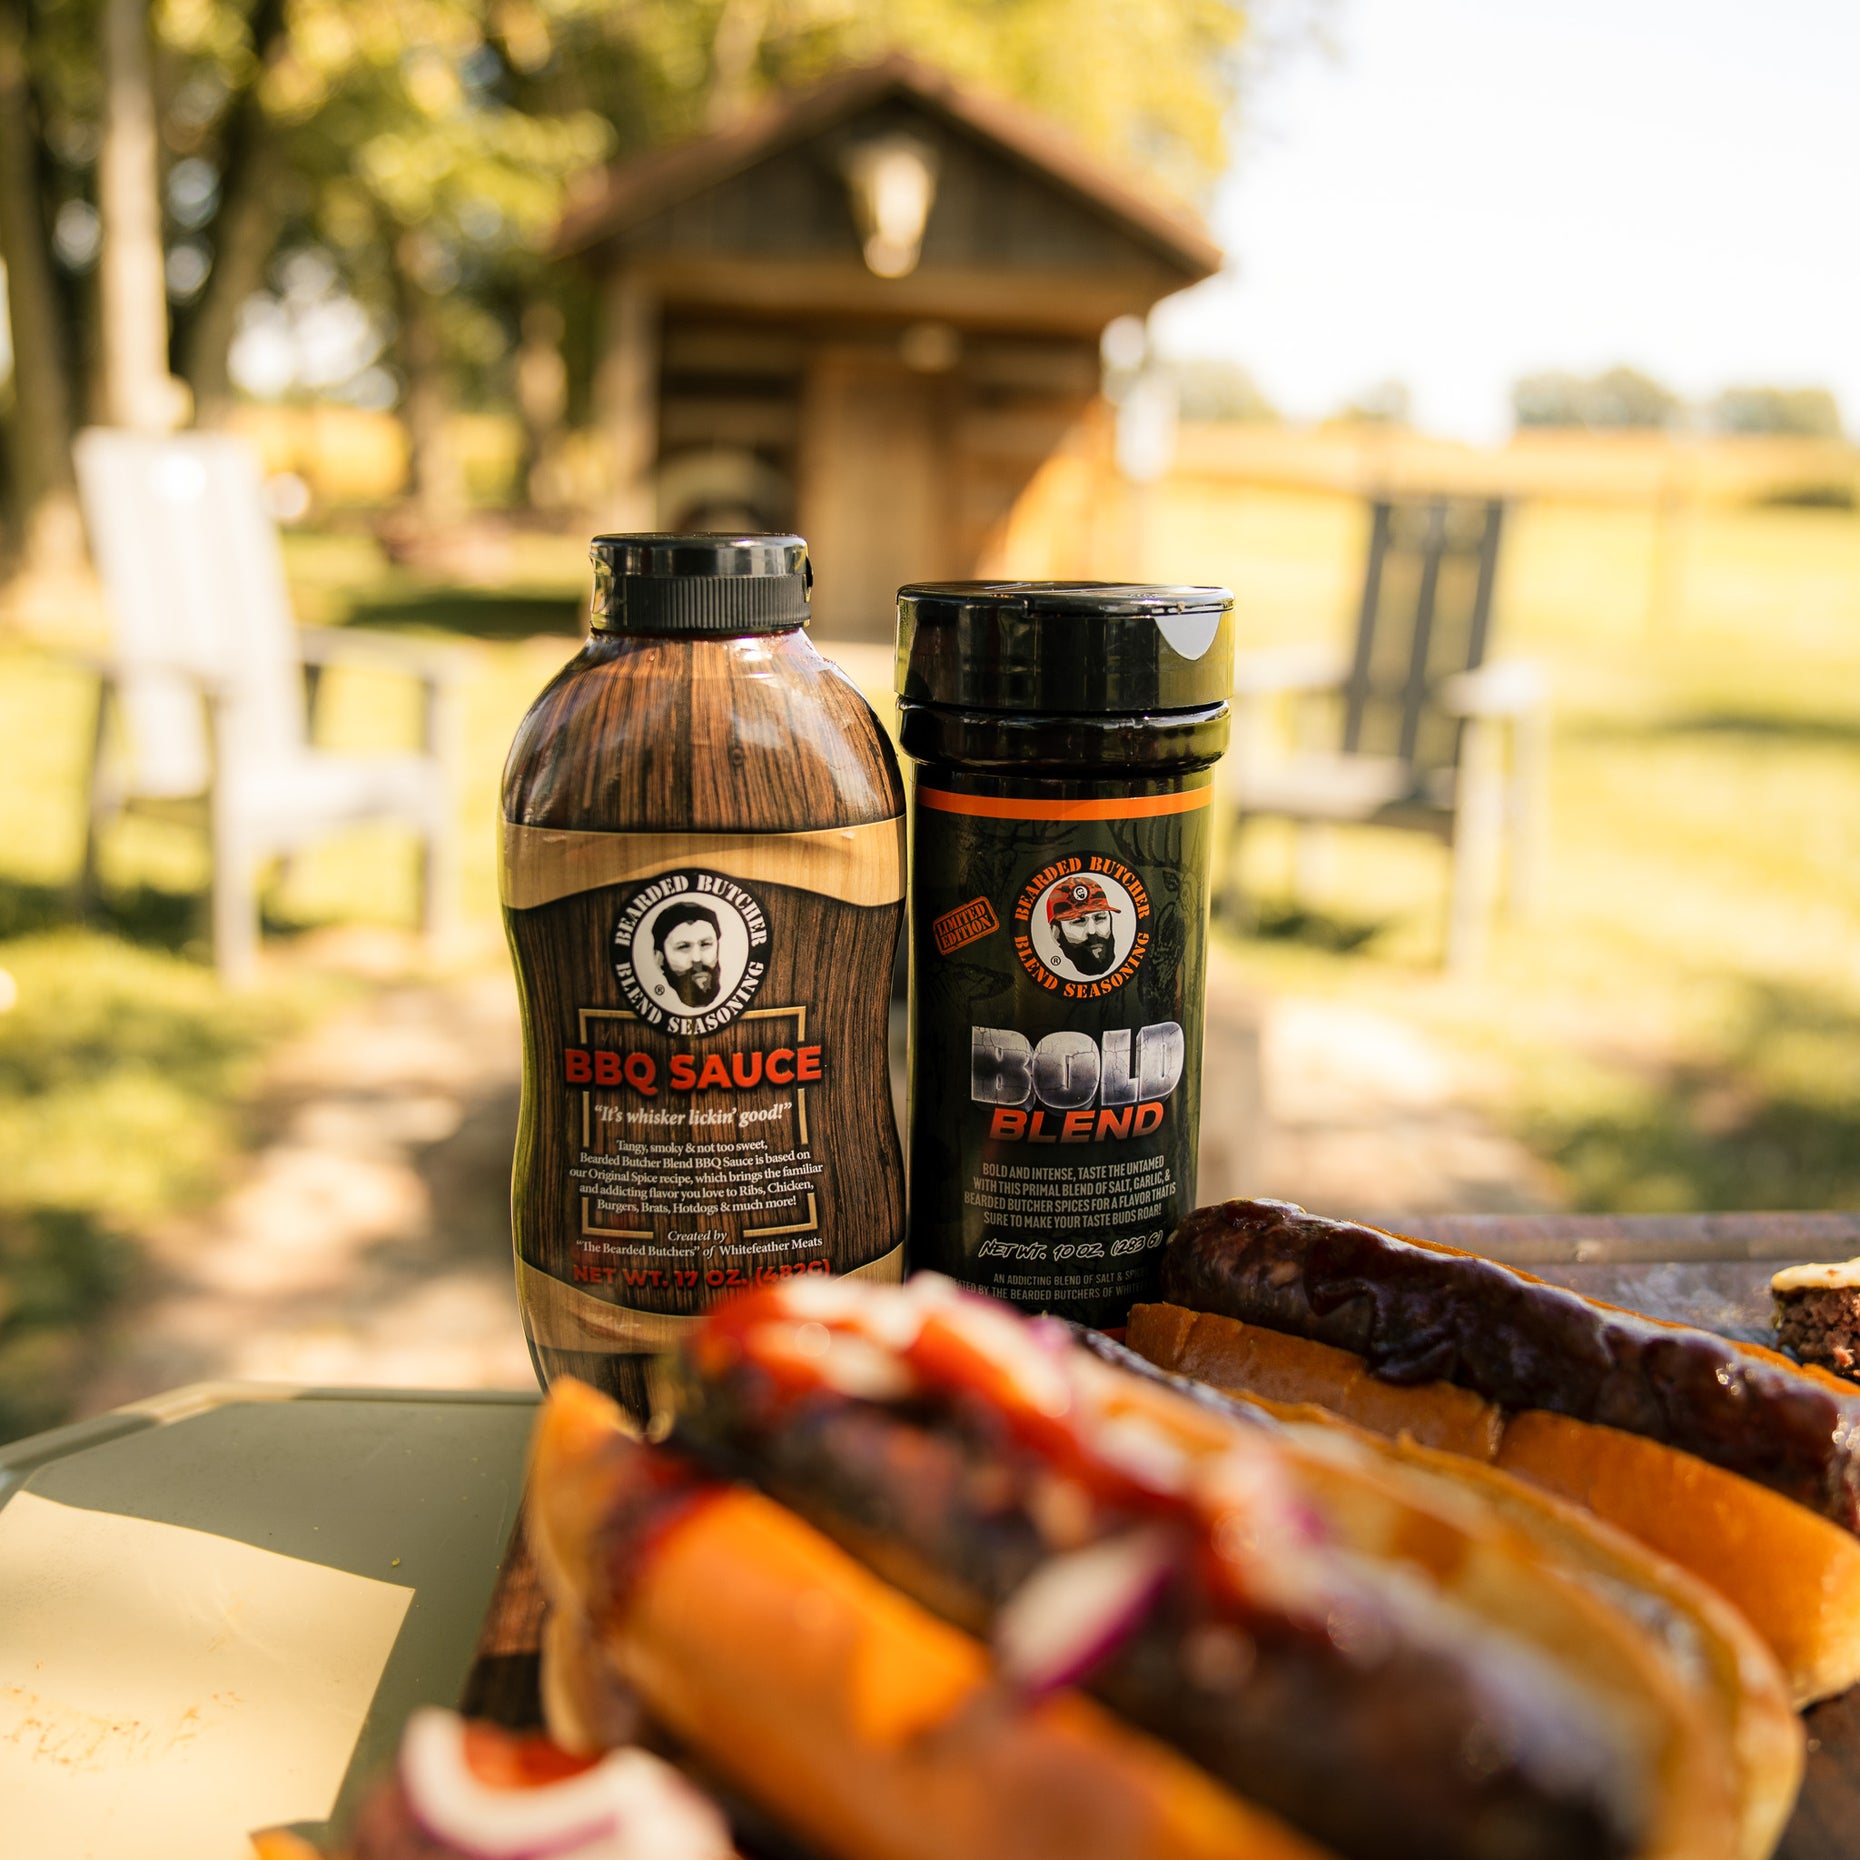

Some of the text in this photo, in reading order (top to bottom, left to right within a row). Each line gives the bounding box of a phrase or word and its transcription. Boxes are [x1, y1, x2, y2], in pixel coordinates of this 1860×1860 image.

[1014, 856, 1150, 922] BEARDED BUTCHER
[614, 874, 769, 947] BEARDED BUTCHER
[937, 903, 985, 936] LIMITED
[941, 914, 991, 949] EDITION
[1014, 932, 1150, 999] BLEND SEASONING
[616, 961, 764, 1036] BLEND SEASONING
[565, 1045, 822, 1096] BBQ SAUCE
[970, 1021, 1185, 1110] BOLD
[626, 1107, 686, 1125] whisker
[989, 1101, 1165, 1144] BLEND
[580, 1150, 811, 1170] Bearded Butcher Blend BBQ Sauce is based on
[616, 1140, 768, 1156] Tangy, smoky & not too sweet,
[569, 1163, 824, 1187] our Original Spice recipe, which brings the familiar
[982, 1154, 1164, 1182] BOLD AND INTENSE, TASTE THE UNTAMED
[579, 1180, 815, 1201] and addicting flavor you love to Ribs, Chicken,
[973, 1168, 1171, 1197] WITH THIS PRIMAL BLEND OF SALT, GARLIC, &
[597, 1195, 797, 1216] Burgers, Brats, Hotdogs & much more!
[964, 1181, 1176, 1213] BEARDED BUTCHER SPICES FOR A FLAVOR THAT IS
[983, 1202, 1162, 1229] SURE TO MAKE YOUR TASTE BUDS ROAR!
[603, 1243, 646, 1256] Bearded
[702, 1245, 716, 1259] of
[719, 1241, 790, 1256] Whitefeather
[791, 1237, 823, 1250] Meats
[667, 1229, 728, 1244] Created by
[978, 1238, 1018, 1258] NET
[1016, 1241, 1048, 1261] WT.
[1052, 1243, 1076, 1262] 10
[1075, 1242, 1105, 1259] OZ.
[572, 1264, 616, 1284] NET
[622, 1267, 669, 1287] WT.
[673, 1270, 698, 1287] 17
[705, 1269, 748, 1287] OZ.
[993, 1273, 1005, 1284] AN
[1006, 1274, 1052, 1286] ADDICTING
[1054, 1275, 1081, 1286] BLEND
[1083, 1274, 1095, 1285] OF
[1095, 1272, 1115, 1284] SALT
[1116, 1270, 1123, 1281] &
[978, 1283, 989, 1296] BY
[991, 1286, 1008, 1299] THE
[1010, 1287, 1052, 1301] BEARDED
[1053, 1289, 1100, 1301] BUTCHERS
[1102, 1286, 1113, 1298] OF
